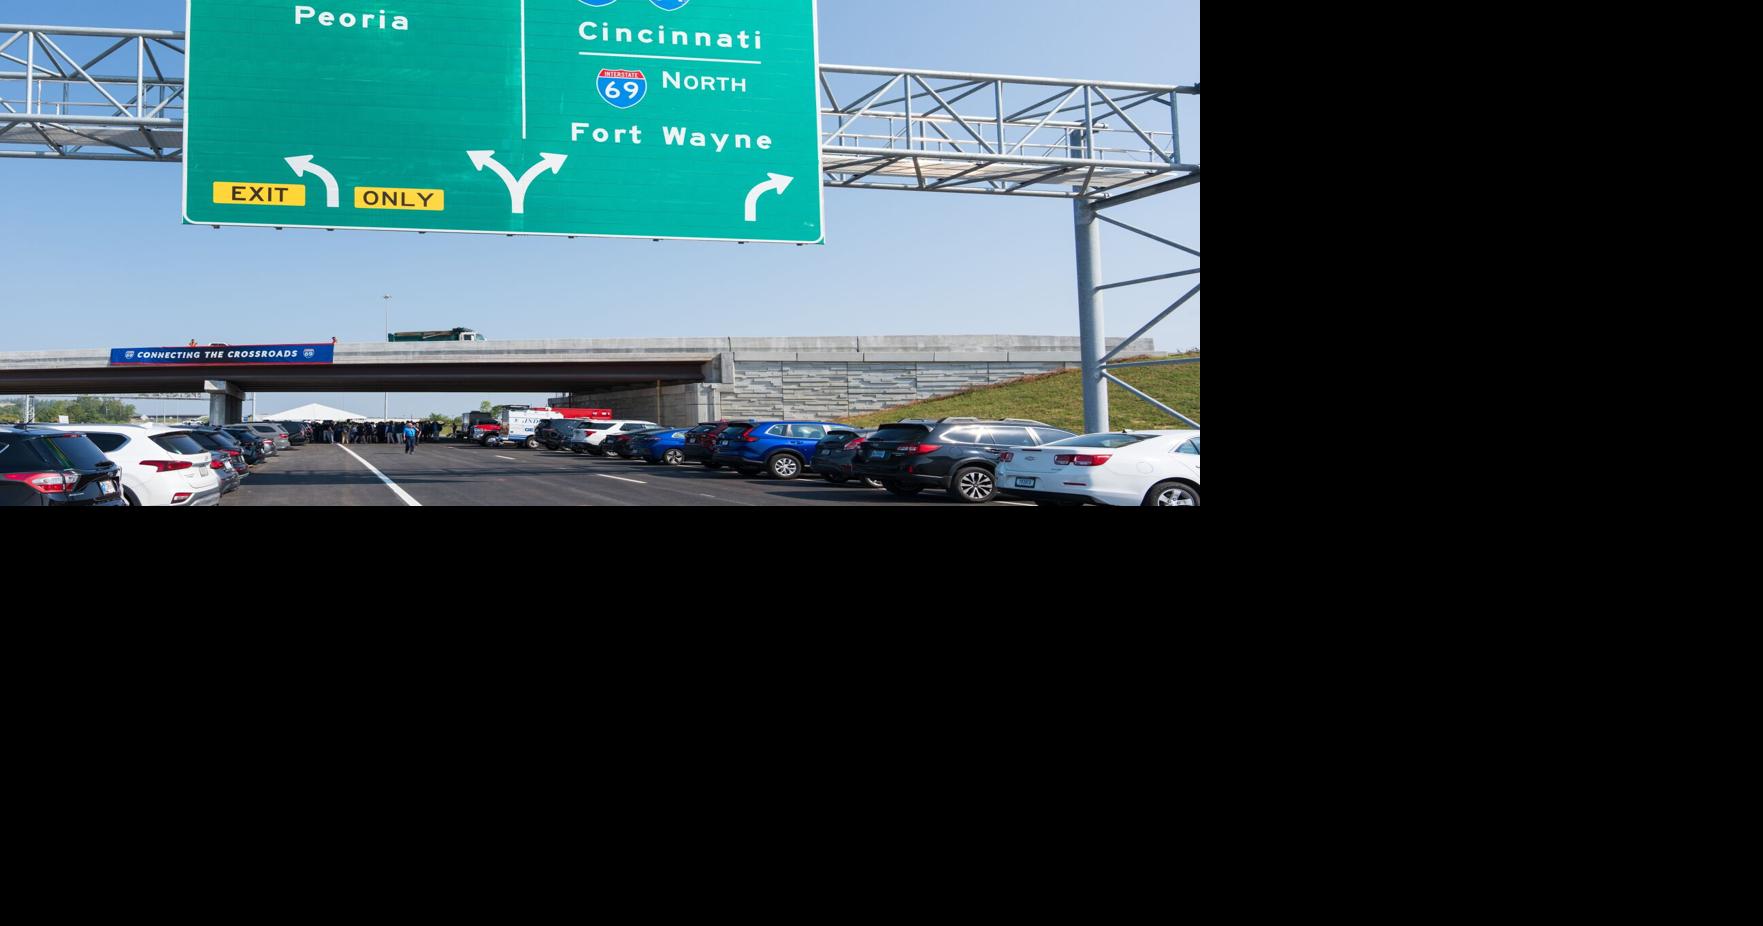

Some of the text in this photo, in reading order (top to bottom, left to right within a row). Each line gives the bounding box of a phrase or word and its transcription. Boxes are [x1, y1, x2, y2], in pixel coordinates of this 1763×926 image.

[295, 5, 409, 31] Peoria
[578, 21, 761, 50] Cincinnati
[604, 71, 639, 79] INTERSTATE
[662, 71, 747, 92] NORTH
[605, 80, 639, 99] 69
[571, 122, 772, 152] Fort Wayne
[231, 186, 289, 203] EXIT
[363, 190, 434, 208] ONLY
[137, 350, 298, 359] CONNECTING THE CROSSROADS
